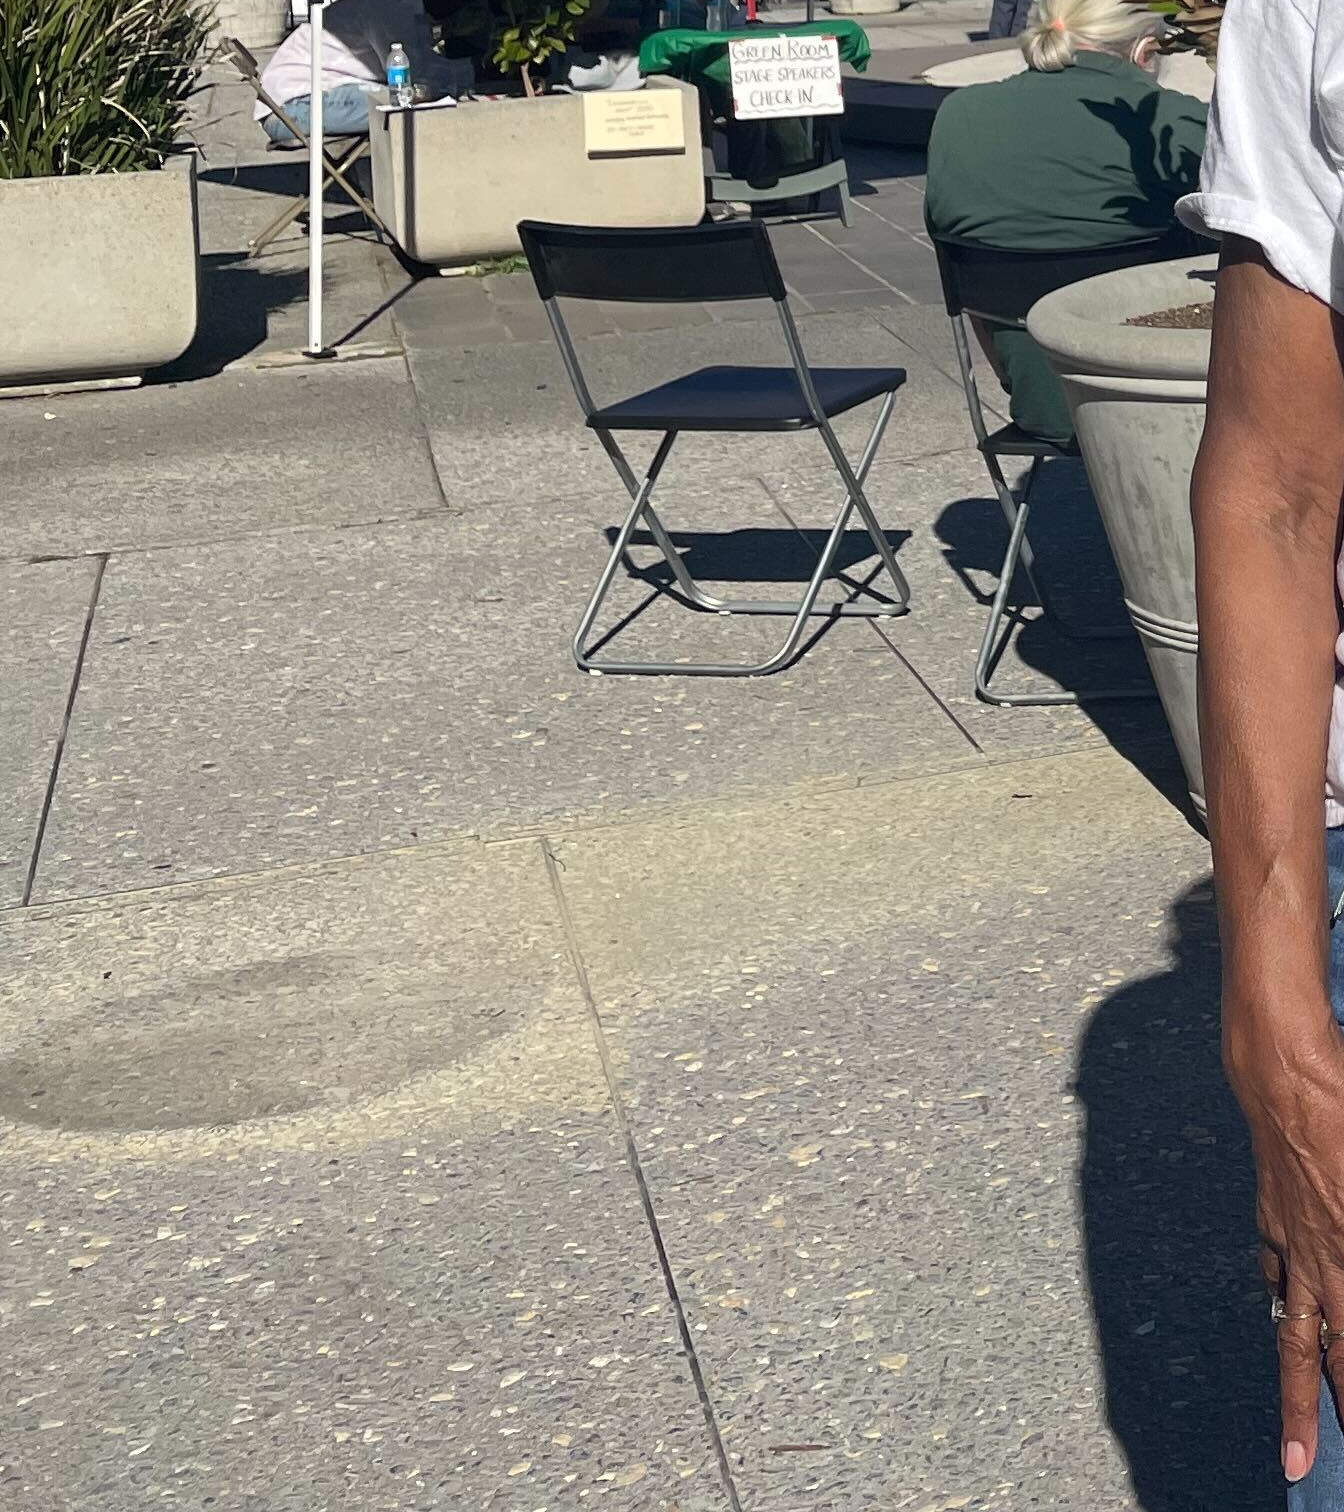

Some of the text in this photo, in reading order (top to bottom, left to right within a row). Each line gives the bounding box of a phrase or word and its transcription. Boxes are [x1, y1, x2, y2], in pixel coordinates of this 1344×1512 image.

[732, 39, 830, 60] GREEN ROOM
[734, 65, 835, 84] STAGE SPEAKERS
[750, 85, 814, 107] CHECK IN
